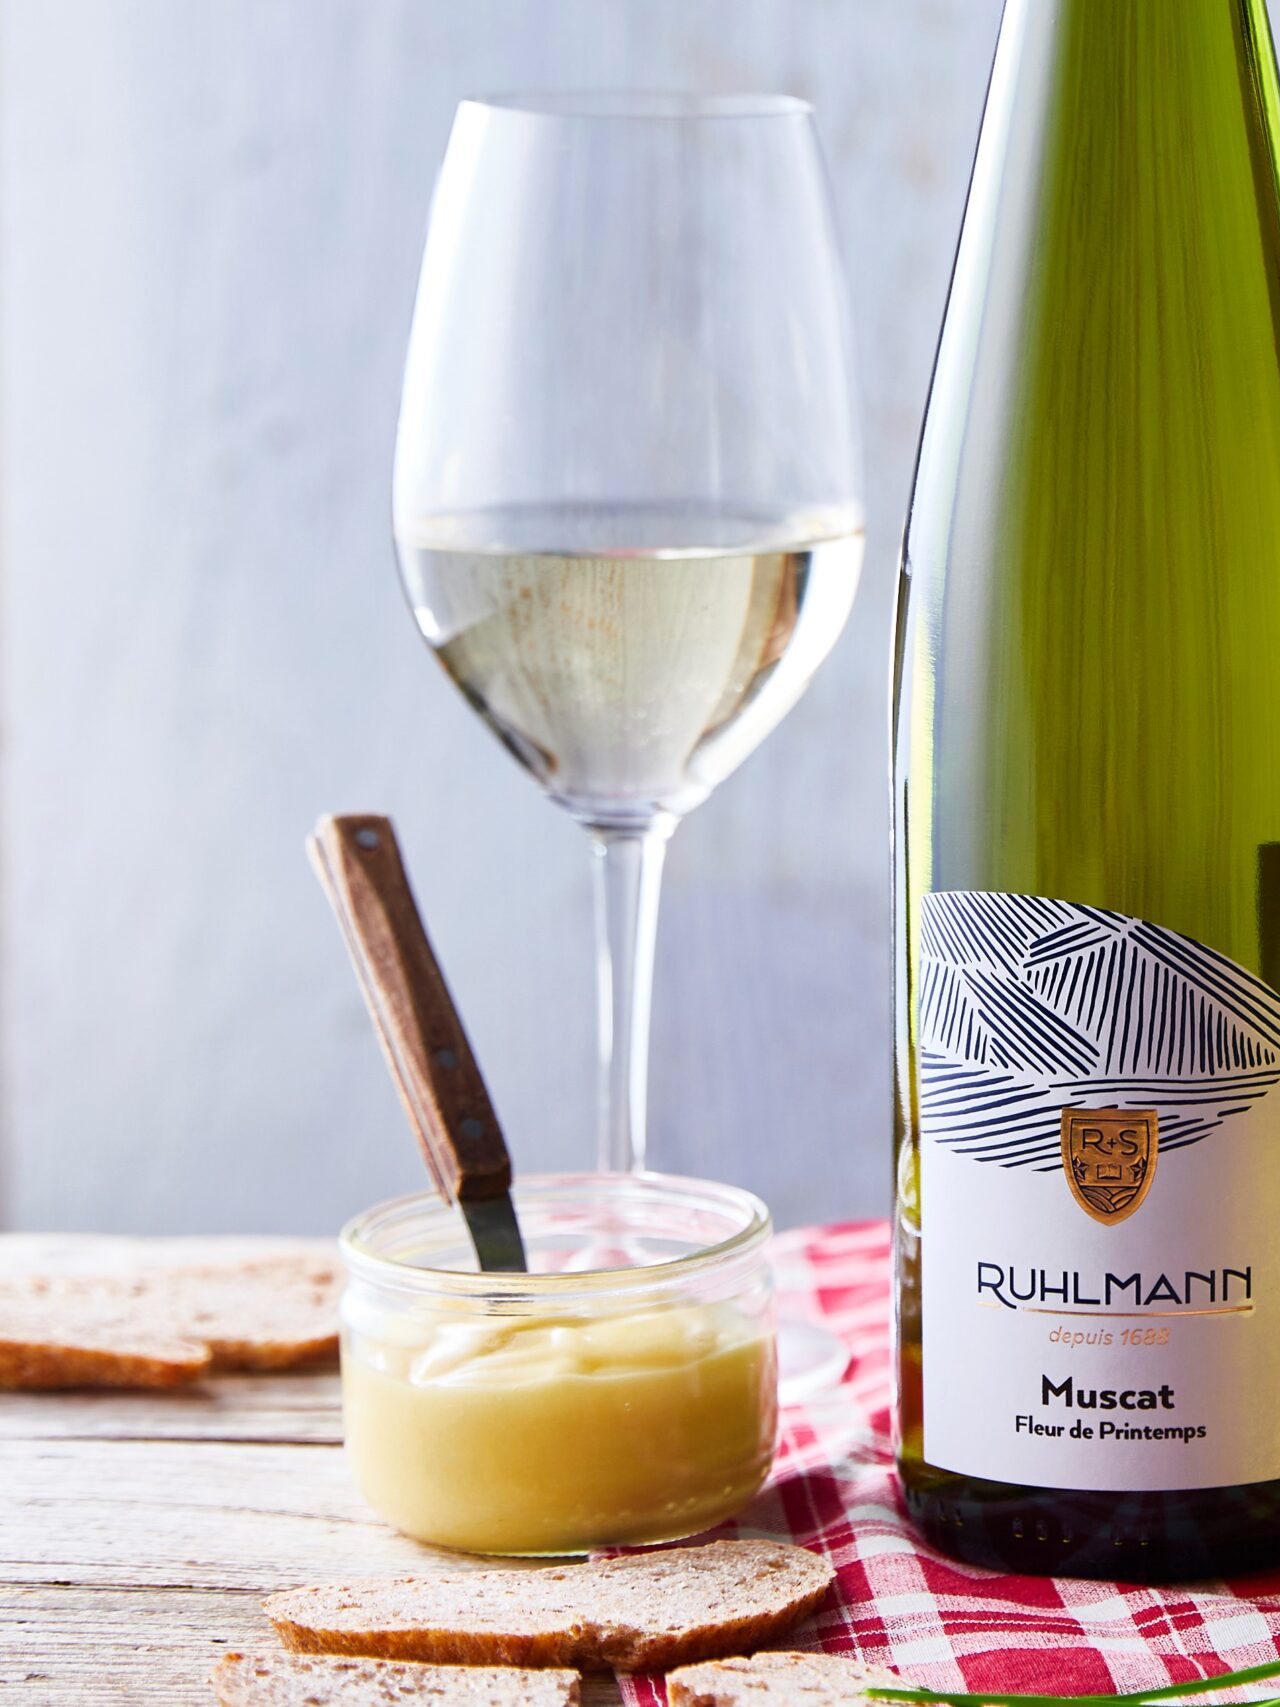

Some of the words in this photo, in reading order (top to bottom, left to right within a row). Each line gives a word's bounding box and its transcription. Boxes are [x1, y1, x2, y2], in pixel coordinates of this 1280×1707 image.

[978, 1262, 1252, 1310] RUHLMANN
[1049, 1326, 1113, 1349] depuis
[1120, 1327, 1170, 1346] 1688
[1041, 1374, 1176, 1410] Muscat
[1015, 1415, 1065, 1437] Fleur
[1069, 1419, 1094, 1440] de
[1099, 1421, 1207, 1444] Printemps
